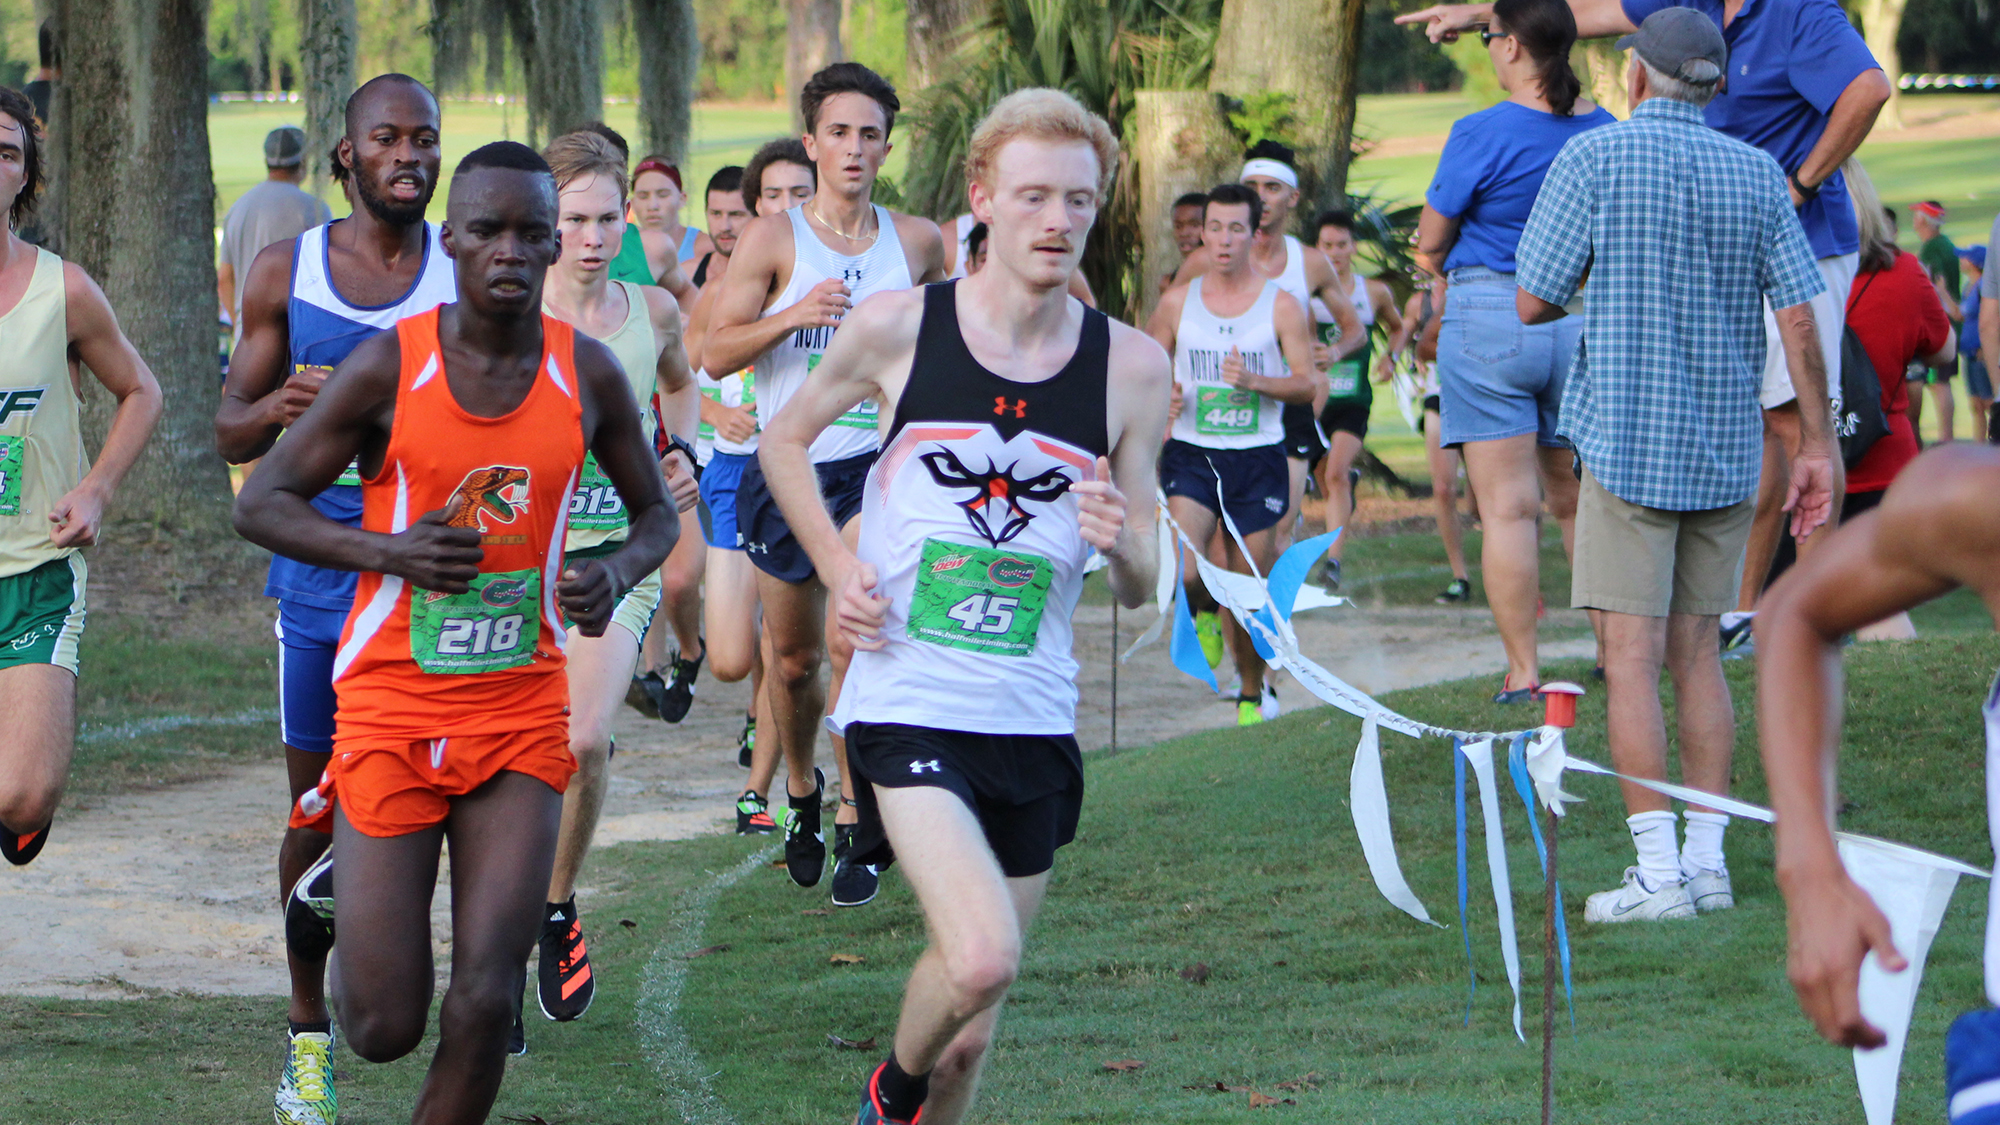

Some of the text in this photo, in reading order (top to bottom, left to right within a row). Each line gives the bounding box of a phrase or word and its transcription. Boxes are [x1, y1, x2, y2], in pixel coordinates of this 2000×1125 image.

[1188, 349, 1220, 381] NORTH
[1204, 408, 1254, 427] 449
[947, 593, 1021, 635] 45
[436, 613, 524, 655] 218
[920, 627, 1028, 649] www.halfmiletiming.com
